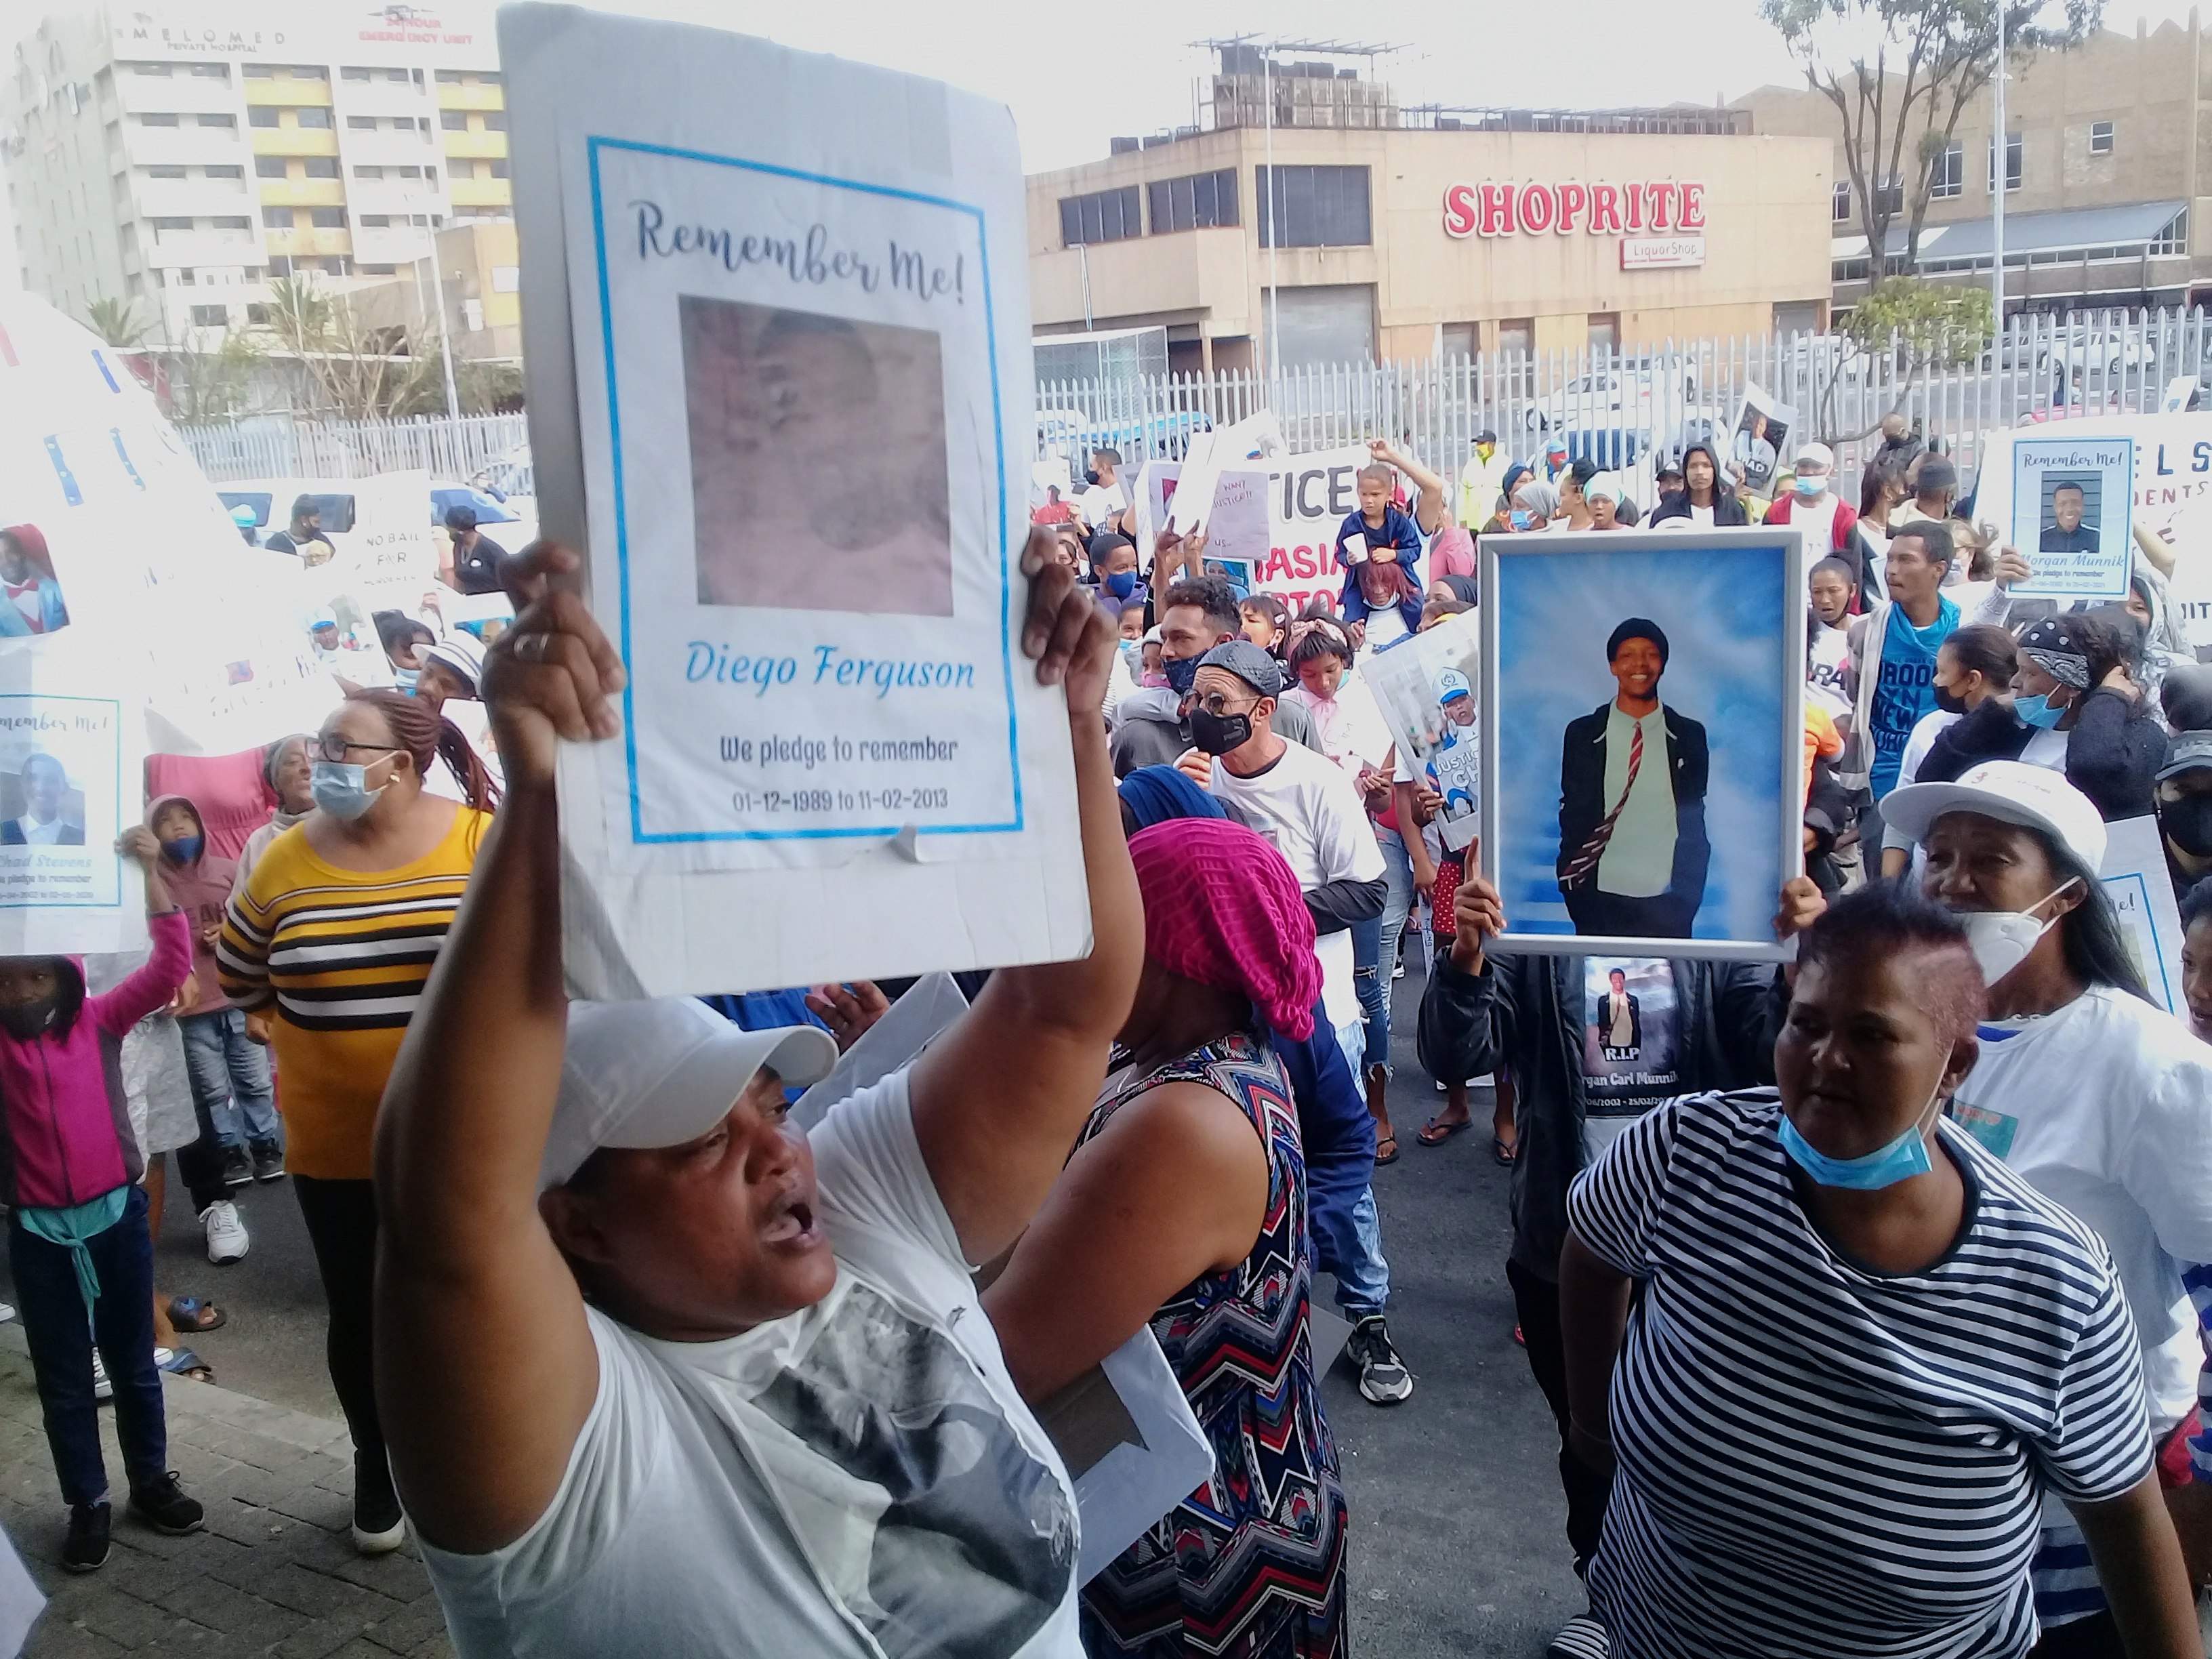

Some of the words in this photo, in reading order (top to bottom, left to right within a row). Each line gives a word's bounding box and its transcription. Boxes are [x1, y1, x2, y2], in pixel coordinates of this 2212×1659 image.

[1443, 179, 1708, 239] SHOPRITE
[628, 200, 881, 293] Remember
[888, 240, 965, 305] Me!
[2022, 452, 2094, 468] Remember
[2096, 452, 2123, 466] Me!
[1269, 465, 1353, 520] ICE
[367, 535, 384, 546] NO
[2071, 554, 2125, 567] Munnik
[686, 640, 797, 698] Diego
[813, 644, 975, 699] Ferguson
[0, 711, 68, 732] member
[720, 735, 753, 763] We
[760, 734, 827, 770] pledge
[832, 735, 853, 762] to
[859, 735, 958, 761] remember
[733, 791, 833, 813] 01-12-1989
[837, 791, 855, 811] to
[859, 787, 949, 810] 11-02-2013
[1605, 1047, 1640, 1061] R.I.P
[1583, 1076, 1609, 1089] rgan
[1610, 1071, 1635, 1086] Carl
